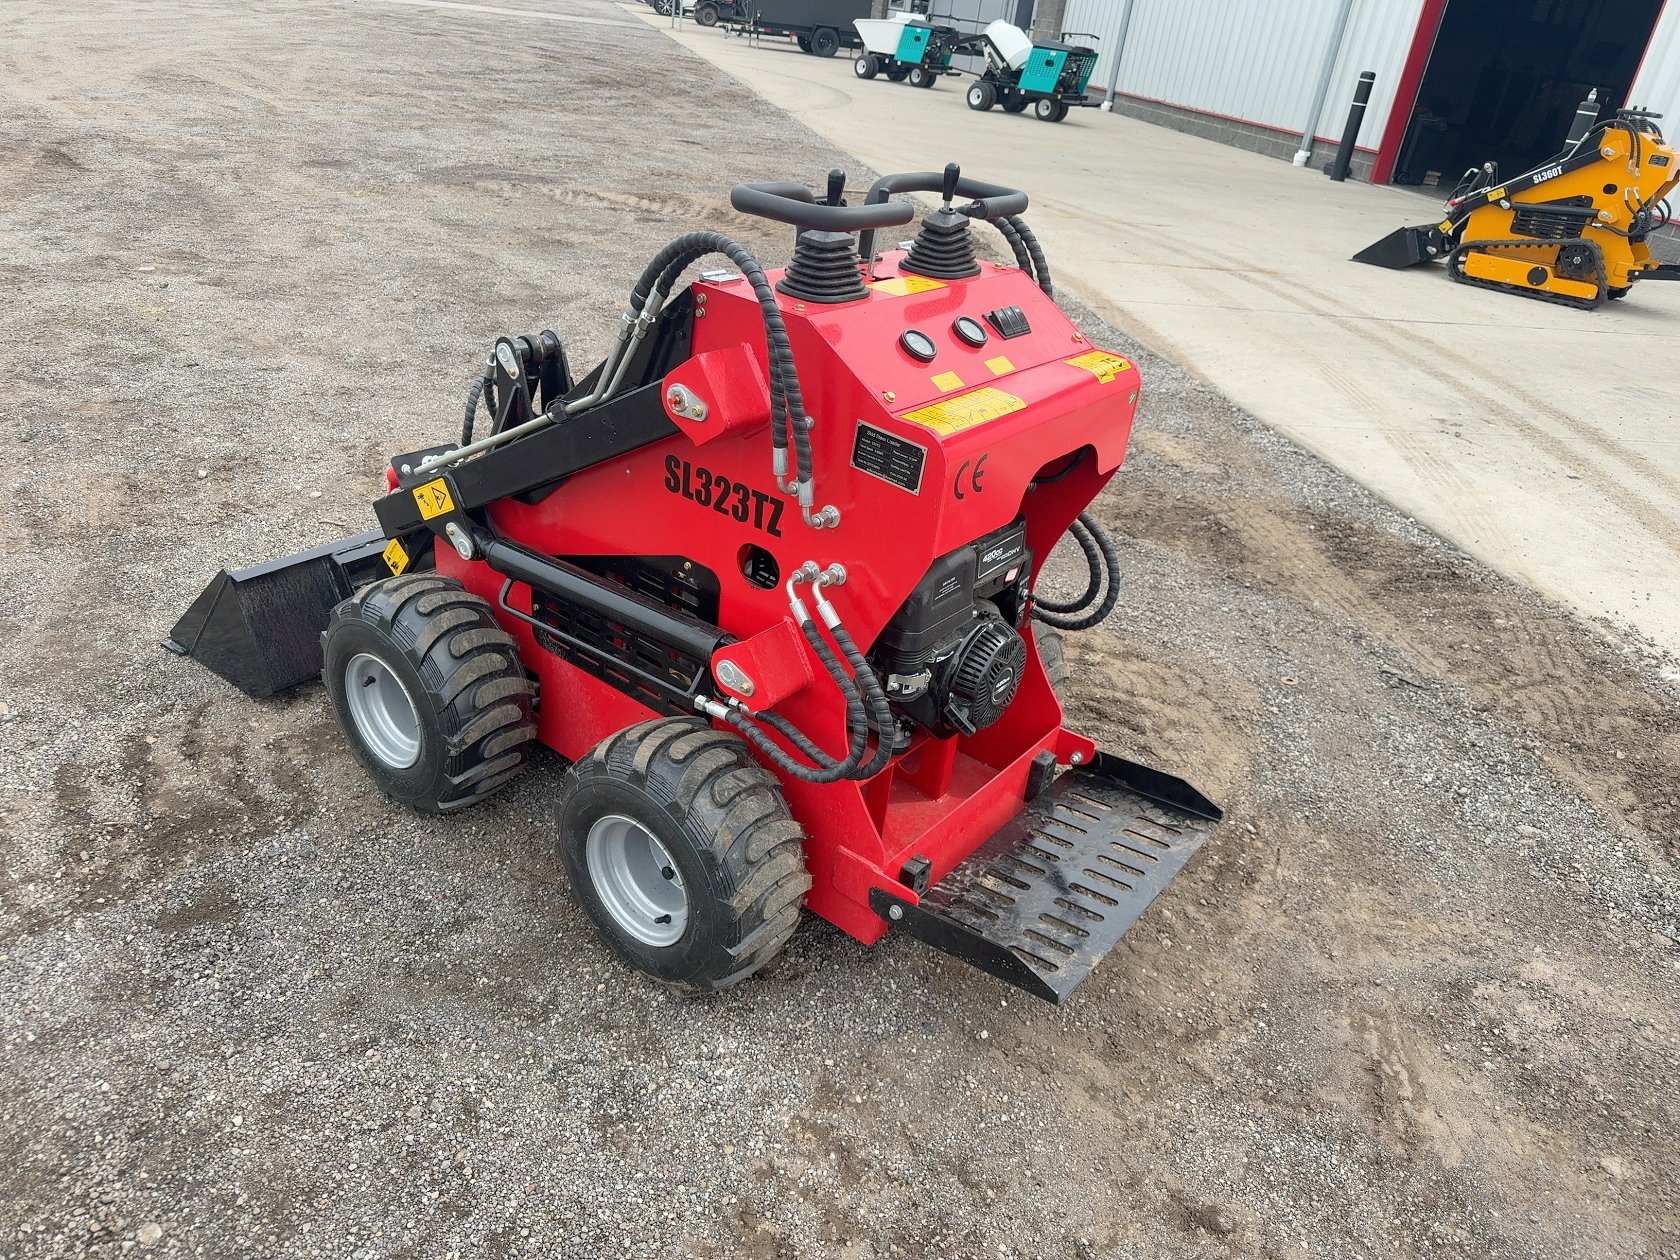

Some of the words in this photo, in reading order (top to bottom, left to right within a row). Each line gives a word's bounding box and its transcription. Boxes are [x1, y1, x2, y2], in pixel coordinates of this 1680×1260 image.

[1532, 166, 1562, 184] SL360T
[954, 454, 988, 499] CE
[664, 454, 784, 538] SL323TZ
[982, 548, 1004, 562] 420cc
